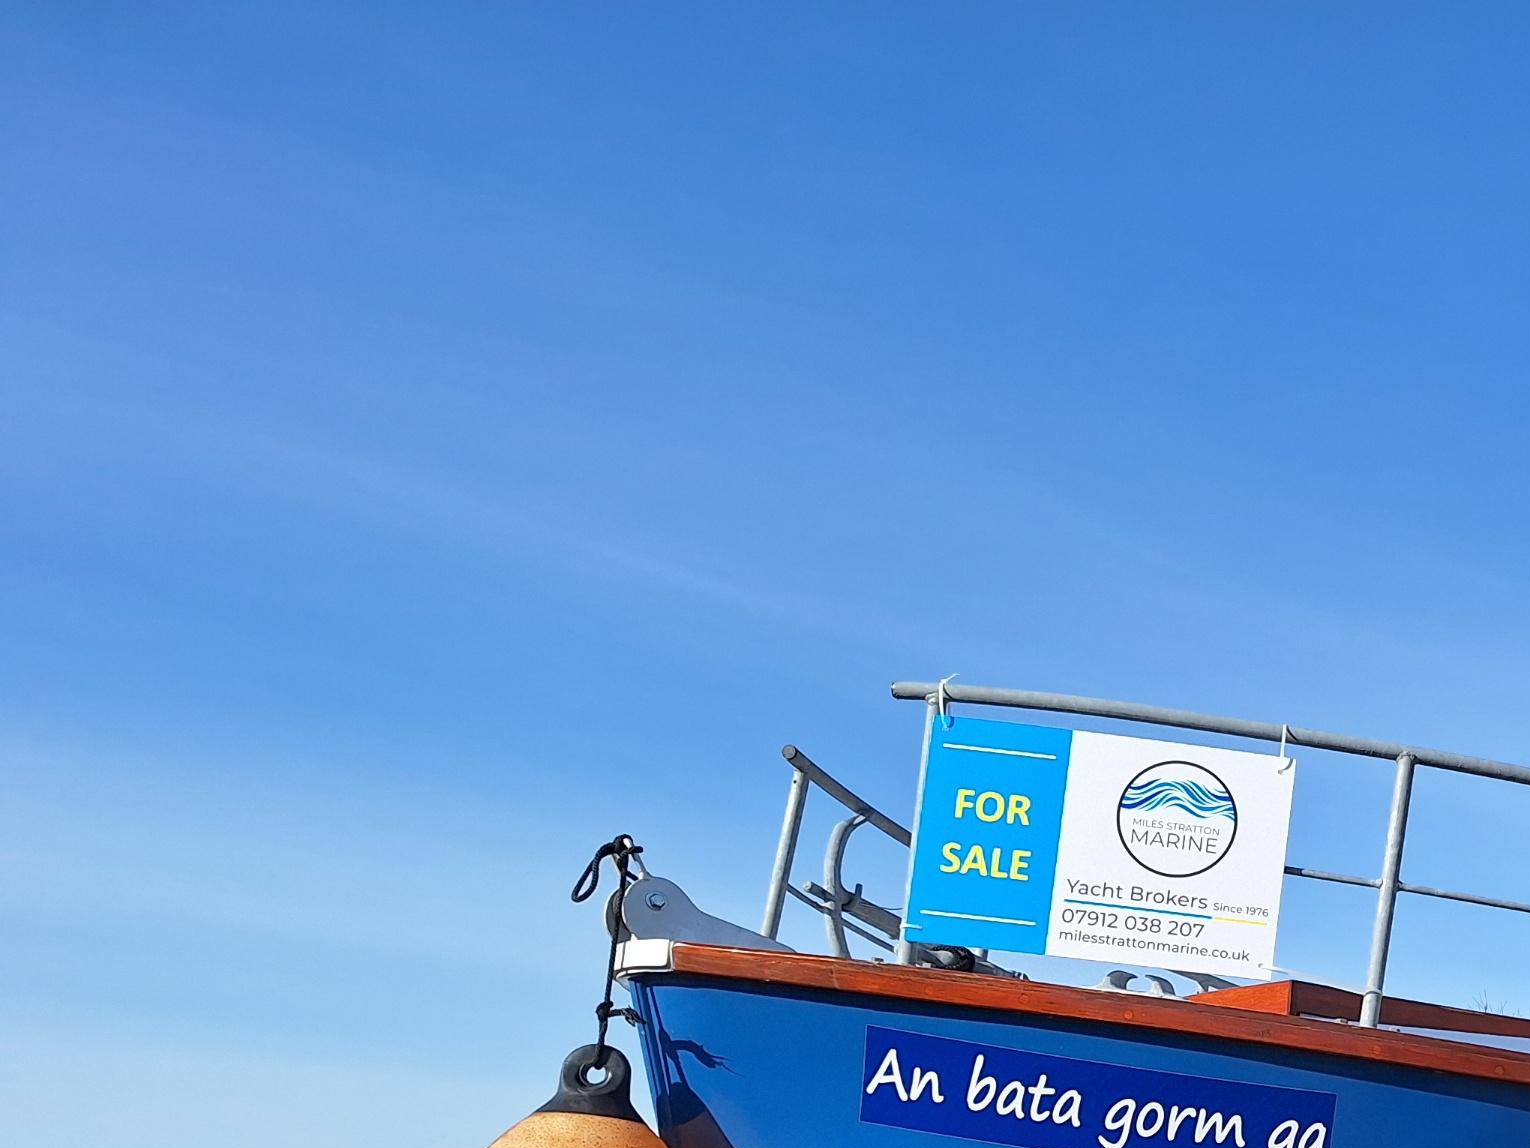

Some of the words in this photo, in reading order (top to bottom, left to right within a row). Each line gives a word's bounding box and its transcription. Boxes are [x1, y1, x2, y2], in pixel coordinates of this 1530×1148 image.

[954, 788, 1031, 826] FOR
[1130, 828, 1218, 854] MARINE
[1132, 818, 1164, 829] MILES
[1166, 821, 1220, 836] STRATTON
[939, 841, 1032, 881] SALE
[1066, 878, 1124, 900] Yacht
[1130, 885, 1208, 910] Brokers
[1212, 902, 1243, 914] Since
[1245, 906, 1269, 918] 1976
[1061, 908, 1118, 929] 07912
[1124, 915, 1162, 934] 038
[1167, 920, 1205, 939] 207
[1059, 930, 1250, 962] milesstrattonmarine.co.uk
[866, 1048, 945, 1103] An
[966, 1054, 1082, 1128] bata
